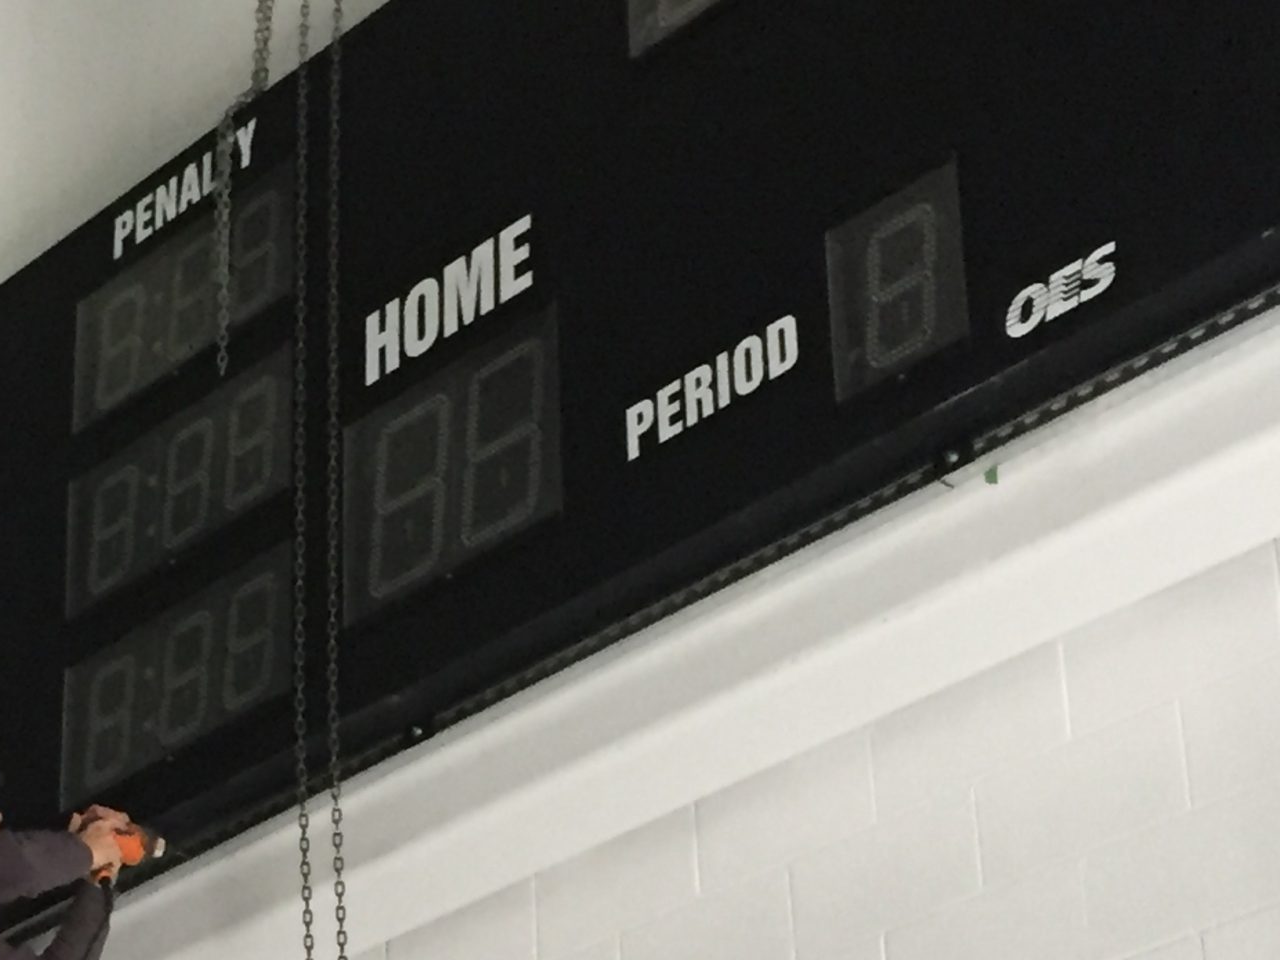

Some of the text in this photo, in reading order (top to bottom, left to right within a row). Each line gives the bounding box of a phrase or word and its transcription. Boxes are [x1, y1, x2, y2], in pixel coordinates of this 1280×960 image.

[113, 117, 257, 260] PENALY
[365, 214, 534, 386] HOME
[1005, 241, 1116, 338] OES
[626, 314, 799, 462] PERIOD
